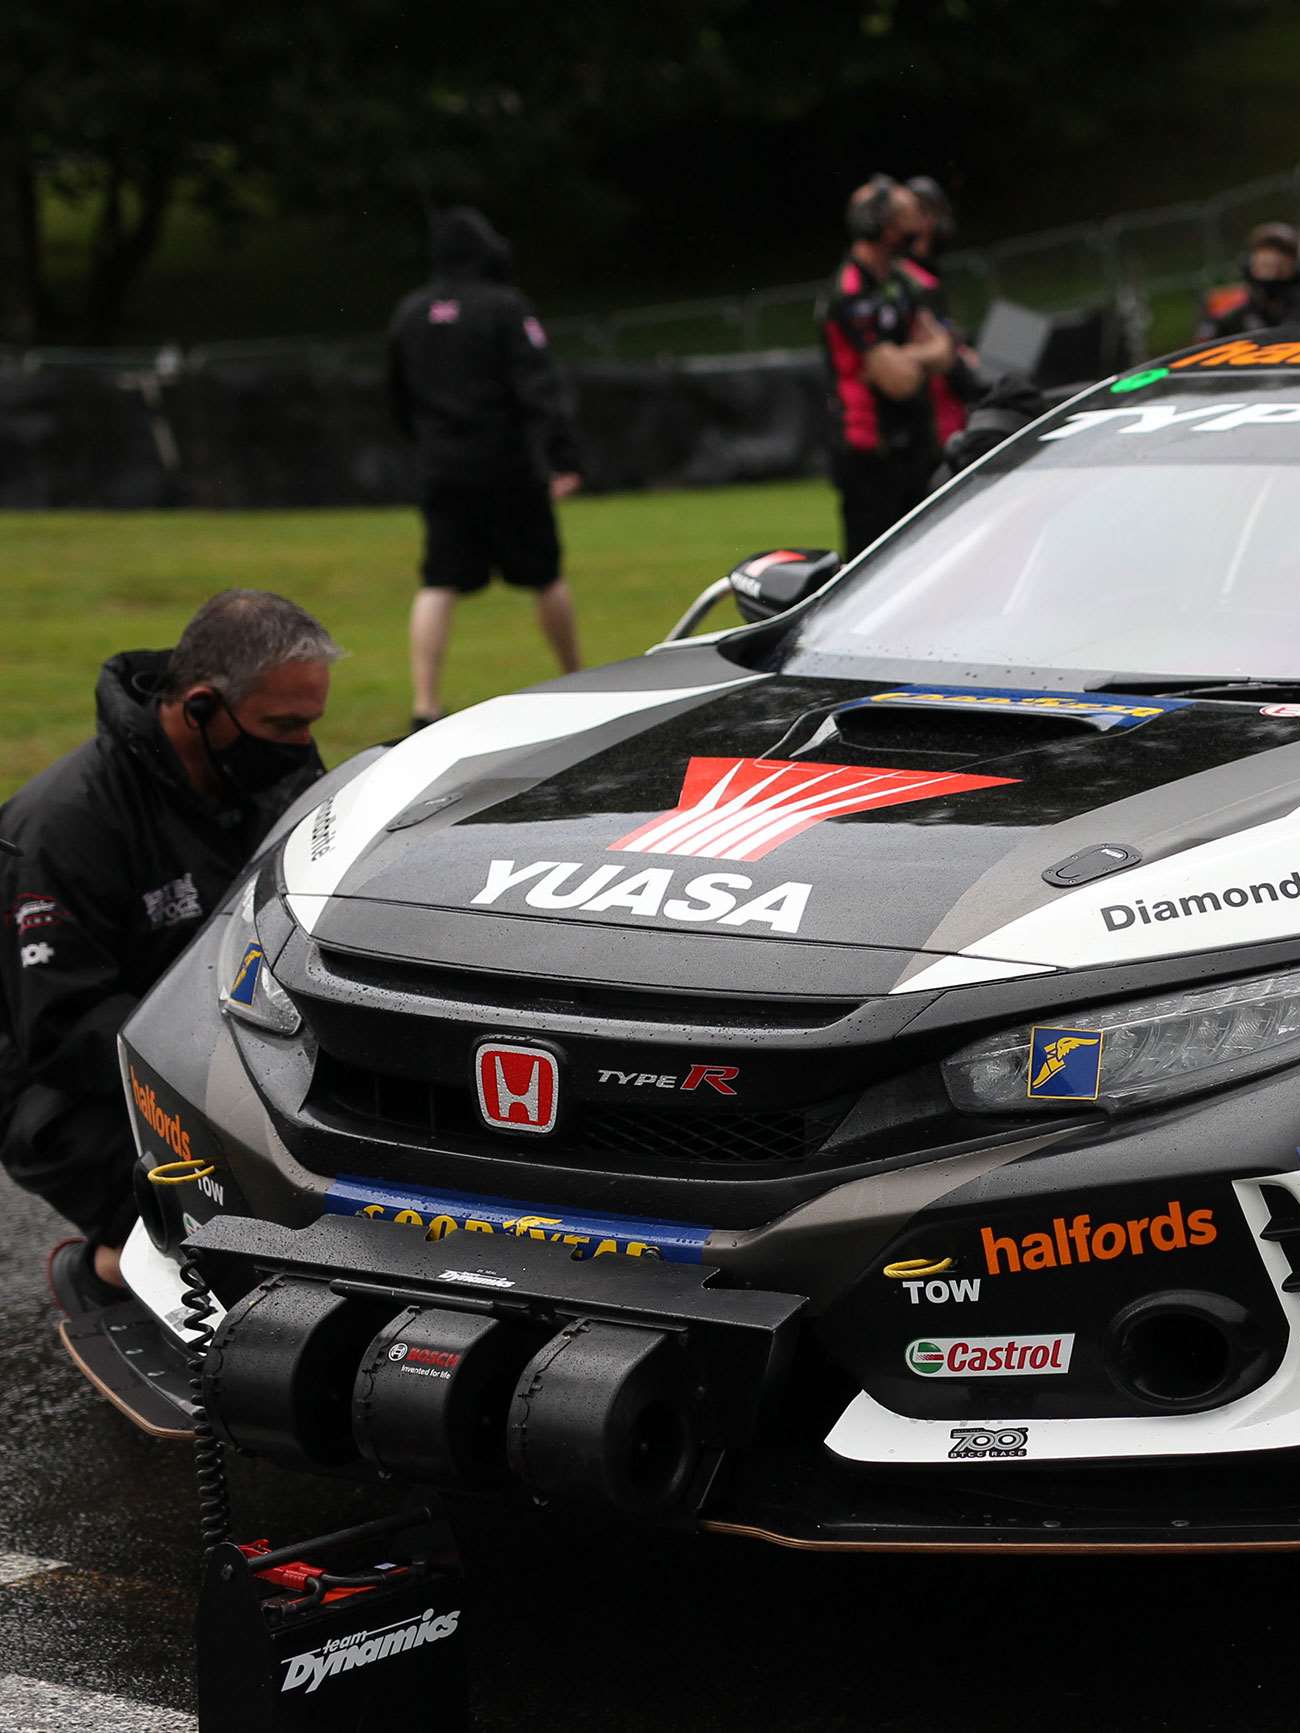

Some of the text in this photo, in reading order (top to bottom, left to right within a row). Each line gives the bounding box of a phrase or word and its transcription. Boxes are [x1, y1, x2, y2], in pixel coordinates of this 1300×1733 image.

[471, 859, 813, 934] YUASA
[598, 1064, 740, 1096] TYPE R
[129, 1064, 192, 1162] halfords
[981, 1201, 1218, 1276] halfords
[903, 1279, 981, 1304] TOW
[405, 1347, 462, 1367] BOSCH
[946, 1337, 1063, 1373] Castrol
[952, 1429, 1025, 1452] 700
[281, 1608, 461, 1694] Dynamics
[323, 1629, 368, 1654] team
